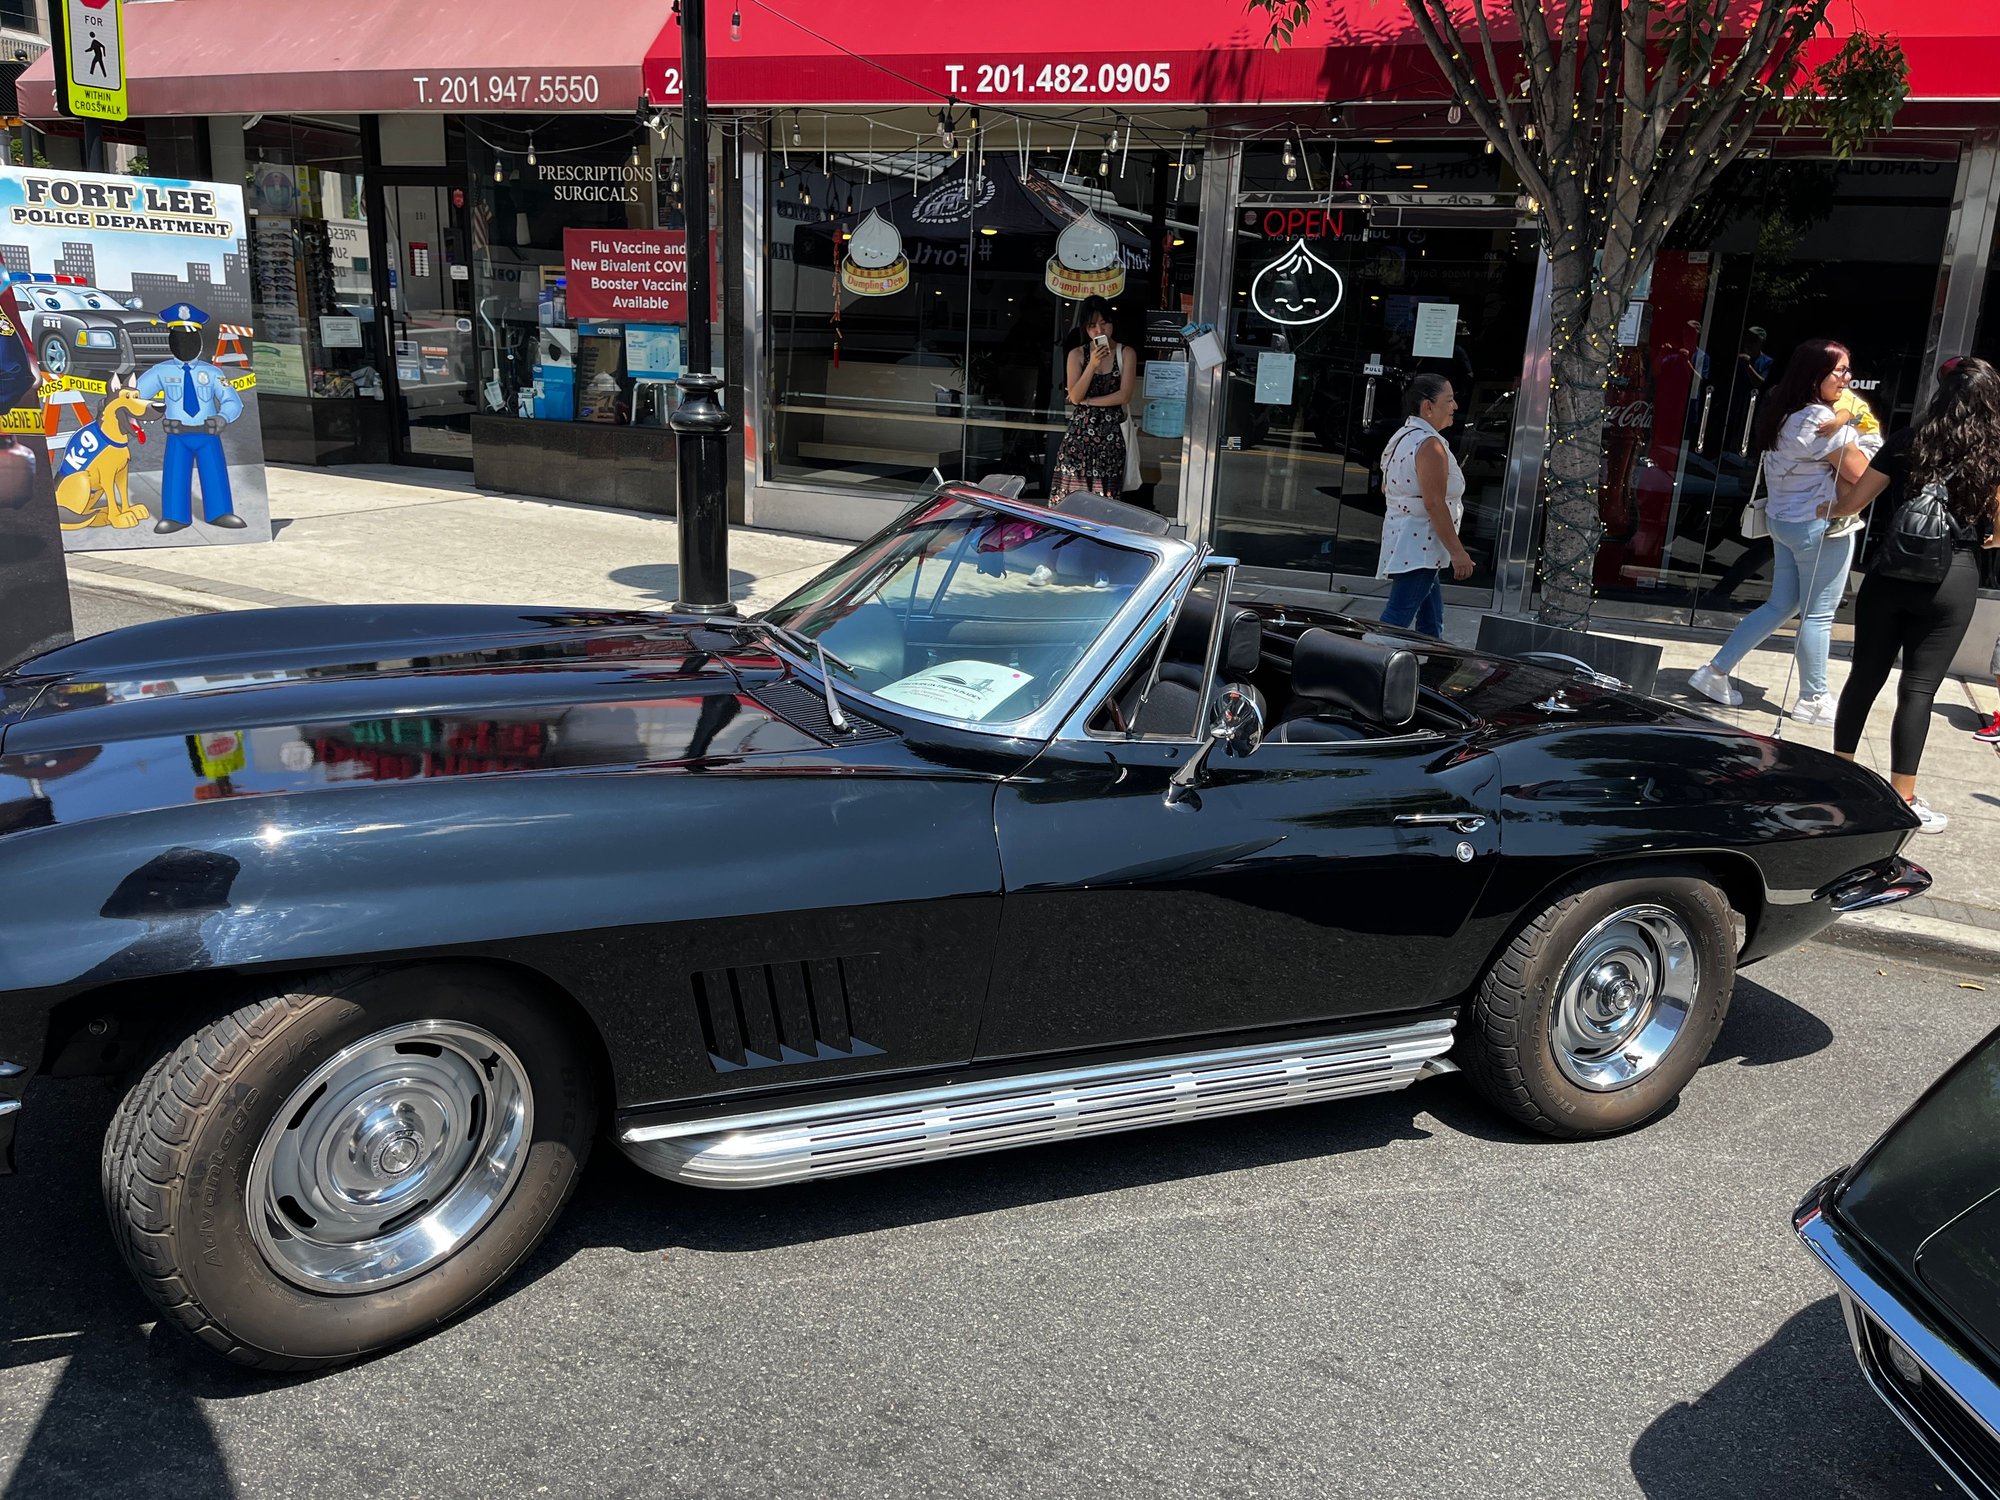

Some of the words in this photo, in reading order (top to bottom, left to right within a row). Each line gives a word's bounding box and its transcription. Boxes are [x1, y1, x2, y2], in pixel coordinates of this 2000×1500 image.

[84, 15, 103, 27] FOR
[945, 64, 967, 93] T.
[976, 62, 1171, 93] 201.482.0905
[84, 90, 111, 102] WITHIN
[413, 77, 433, 103] T.
[439, 75, 599, 104] 201.947.5550
[74, 100, 122, 115] CROSSWALK
[538, 165, 653, 182] PRESCRIPTIONS
[26, 178, 135, 210] FORT
[145, 188, 214, 216] LEE
[553, 185, 639, 202] SURGICALS
[13, 208, 90, 226] POLICE
[96, 213, 230, 236] DEPARTMENT
[1263, 209, 1343, 238] OPEN
[590, 240, 610, 254] Flu
[612, 241, 661, 255] Vaccine
[571, 258, 597, 271] New
[600, 259, 650, 272] Bivalent
[653, 261, 687, 273] COVI
[591, 277, 639, 290] Booster
[847, 275, 884, 291] Dumpling
[887, 276, 904, 287] Den
[1052, 276, 1095, 295] Dumpling
[1099, 282, 1118, 293] Den
[612, 296, 669, 310] Available
[43, 319, 62, 329] 911
[597, 327, 620, 335] CONAIR
[38, 380, 63, 396] ROSS
[69, 378, 102, 393] POLICE
[233, 379, 245, 389] DO
[246, 375, 257, 387] NO
[1848, 379, 1881, 391] our
[2, 409, 31, 429] SCENE
[65, 430, 99, 471] K-9
[199, 1087, 261, 1268] Advantage
